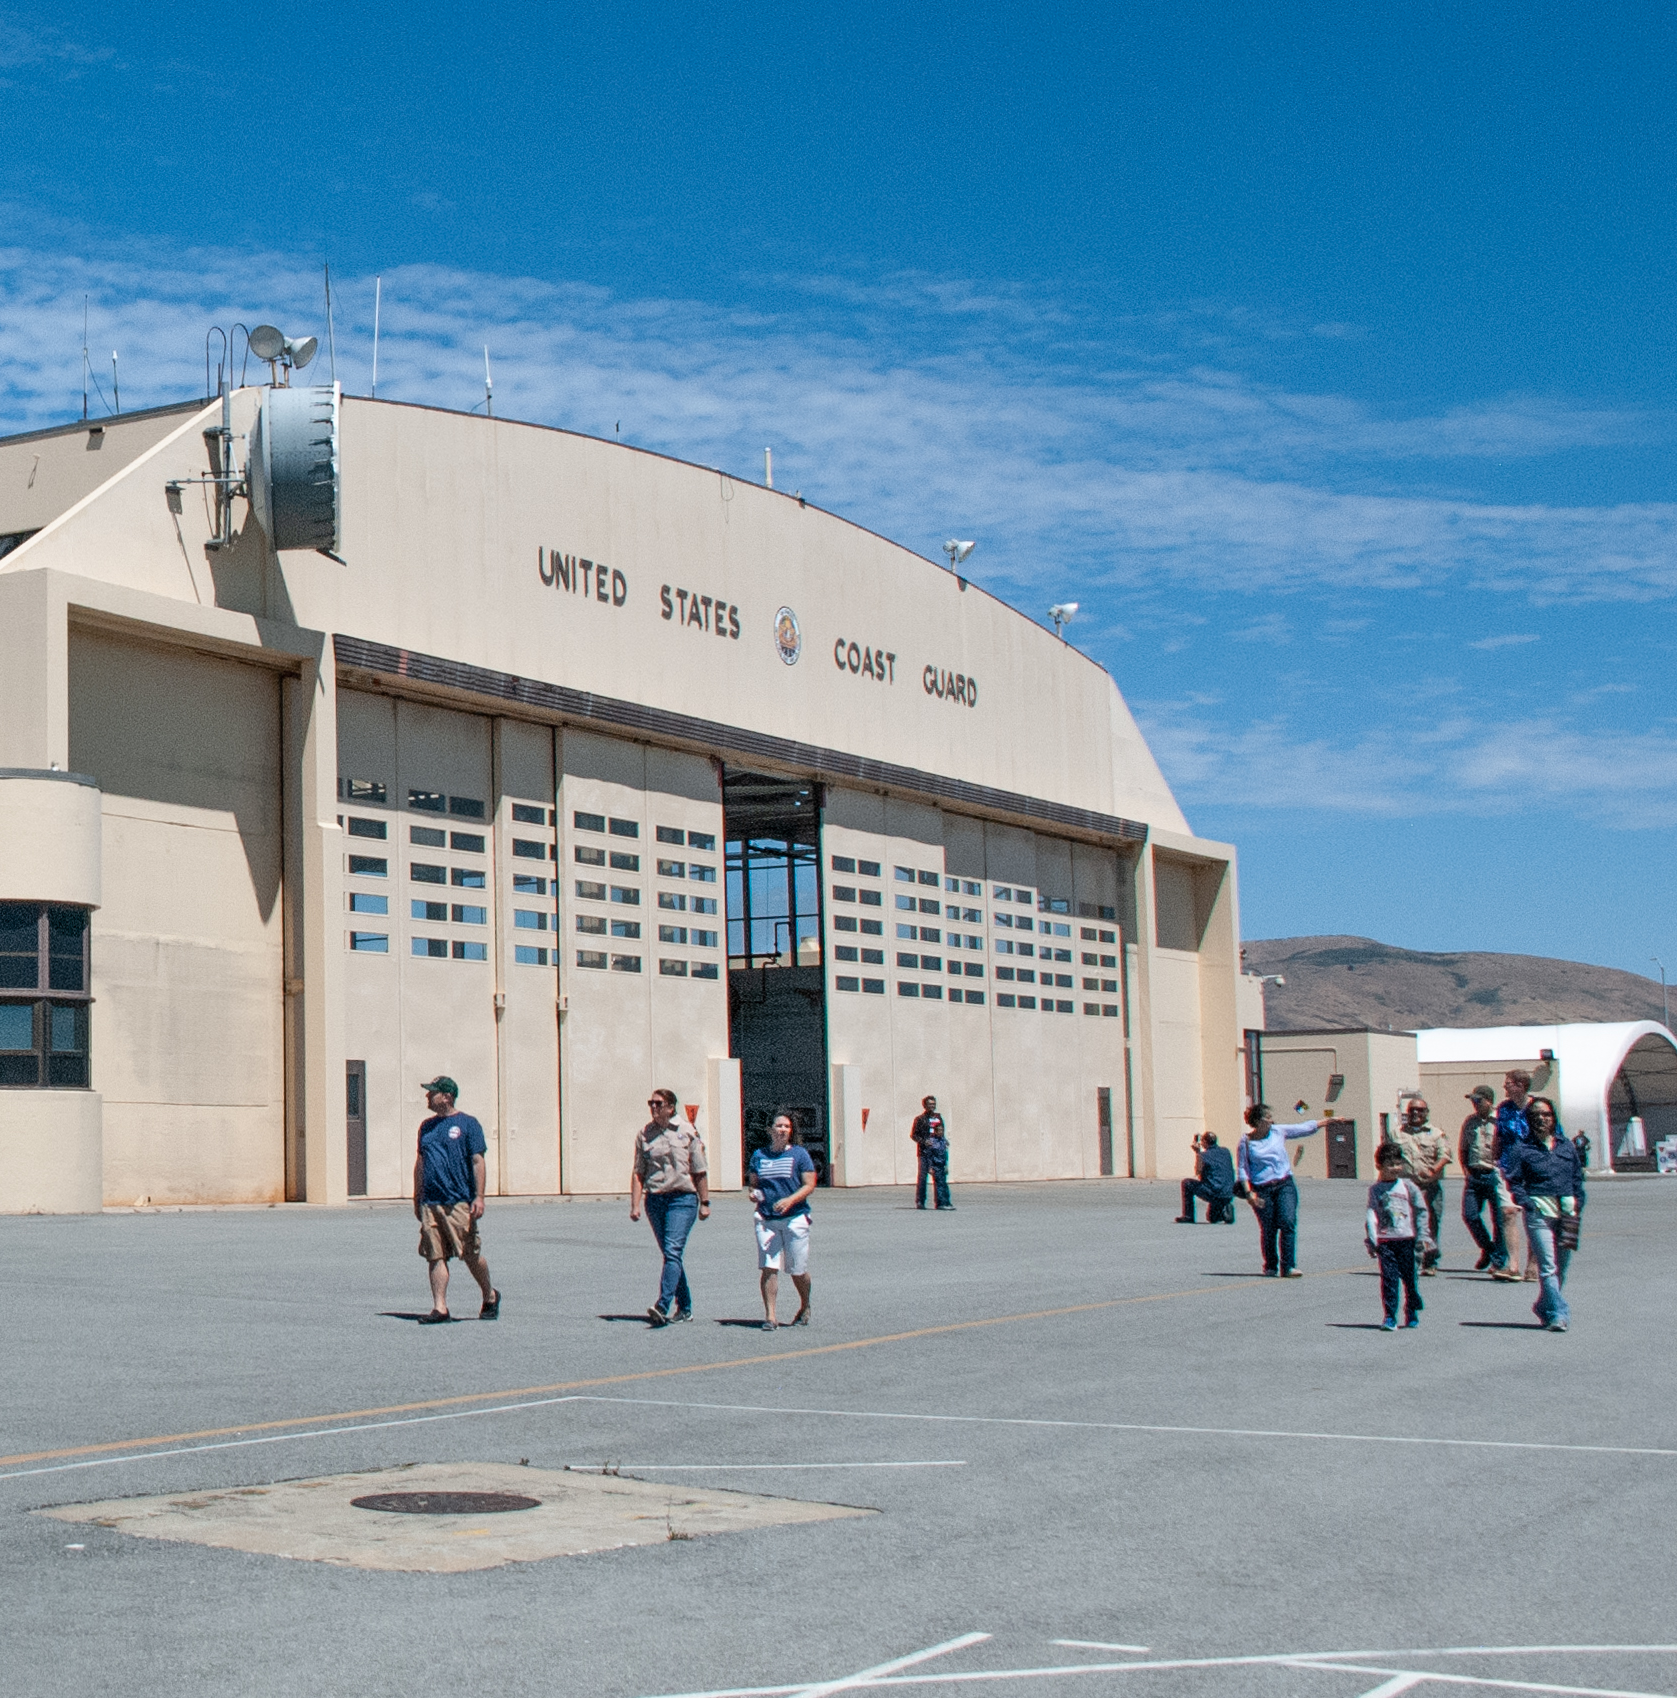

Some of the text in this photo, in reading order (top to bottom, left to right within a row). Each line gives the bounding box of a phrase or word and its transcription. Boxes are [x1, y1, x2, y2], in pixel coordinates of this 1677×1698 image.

[538, 546, 627, 608] UNITED
[660, 584, 741, 640] STATES
[834, 637, 896, 684] COAST
[923, 664, 978, 708] GUARD
